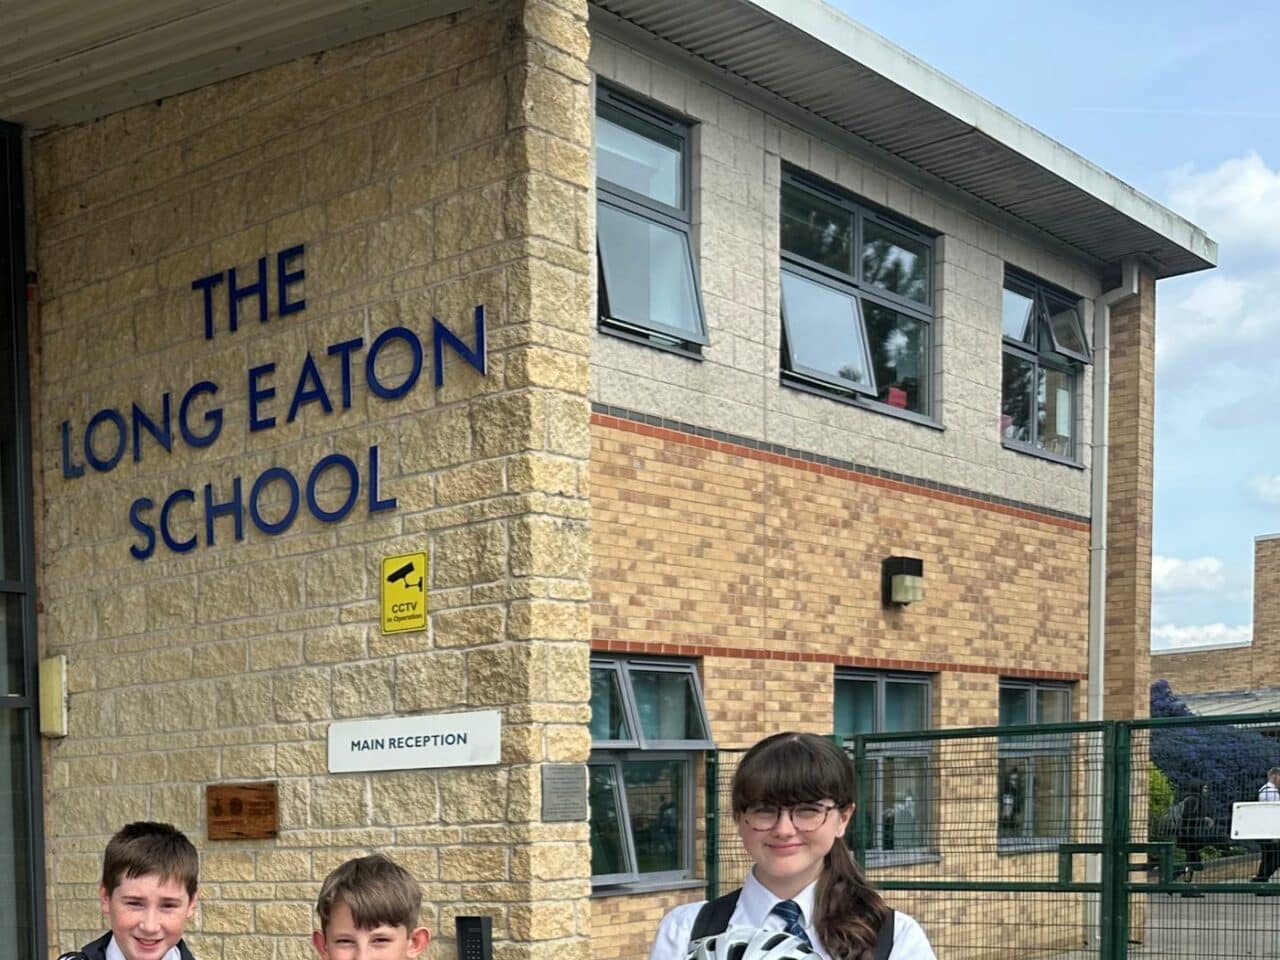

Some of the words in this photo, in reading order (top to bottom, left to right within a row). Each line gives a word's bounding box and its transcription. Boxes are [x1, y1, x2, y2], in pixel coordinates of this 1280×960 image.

[191, 244, 306, 340] THE
[61, 381, 224, 479] LONG
[248, 304, 488, 432] EATON
[128, 445, 397, 562] SCHOOL
[391, 601, 418, 614] CCTV
[351, 738, 385, 752] MAIN
[388, 733, 468, 749] RECEPTION
